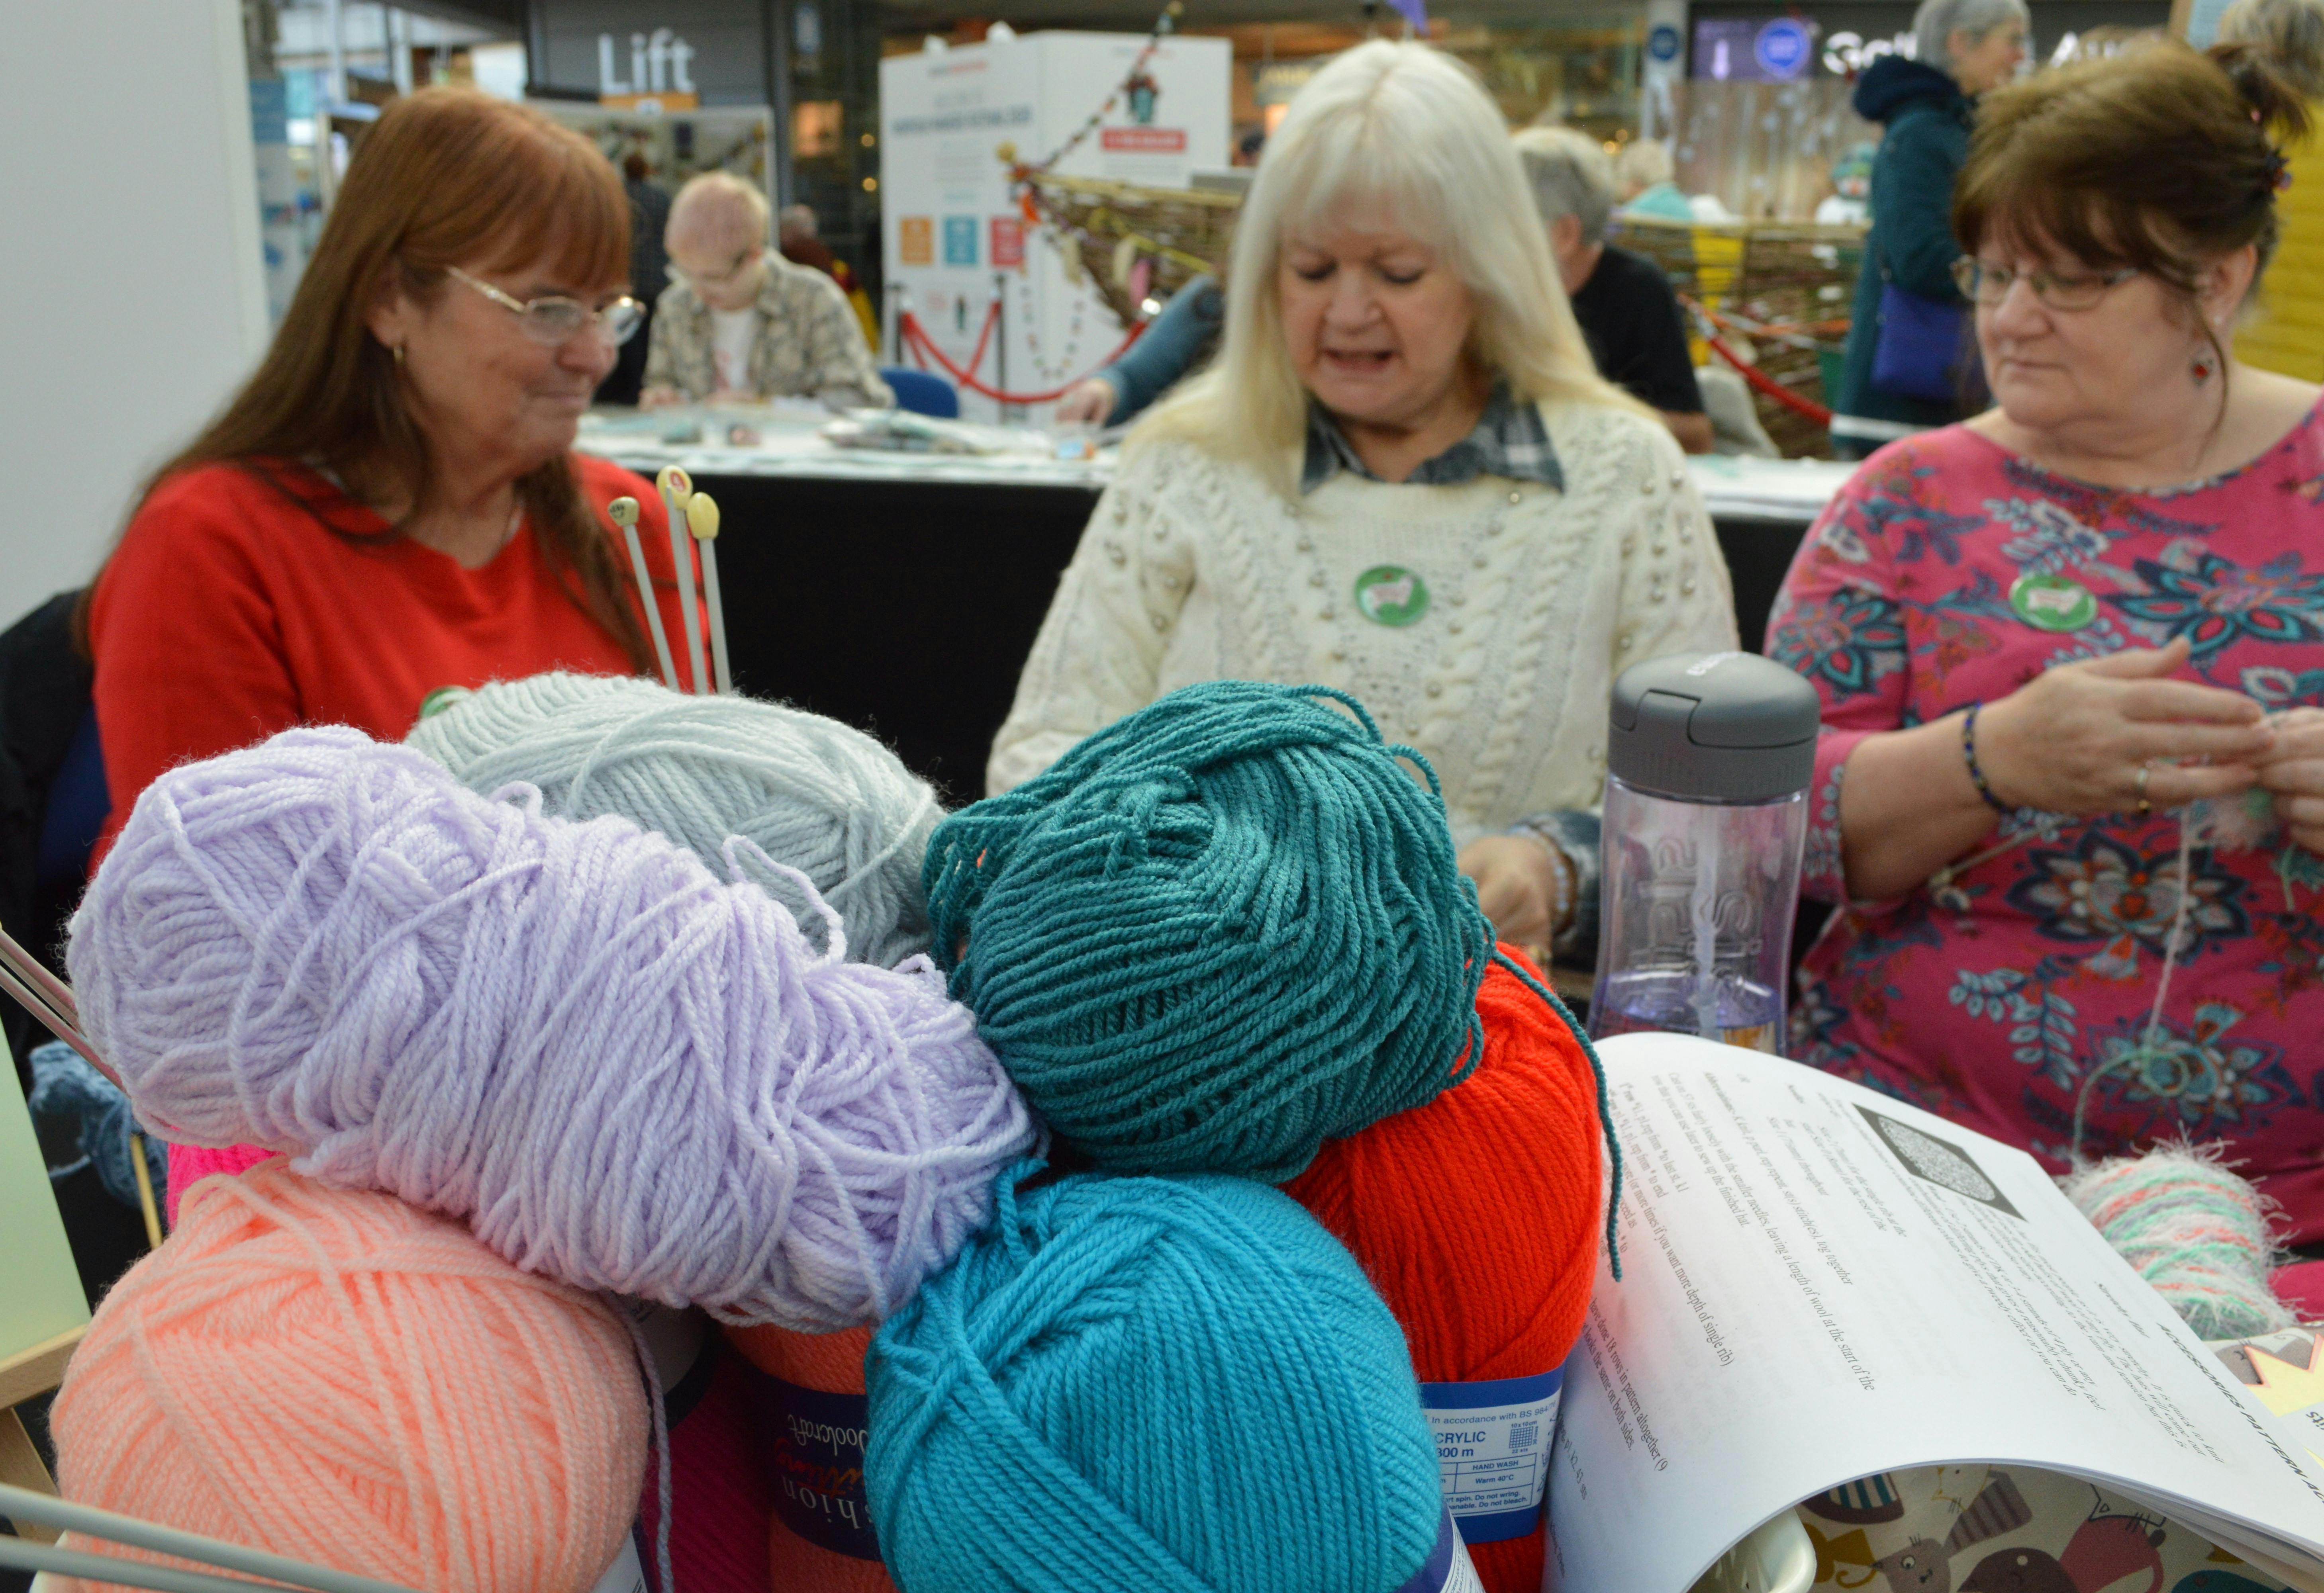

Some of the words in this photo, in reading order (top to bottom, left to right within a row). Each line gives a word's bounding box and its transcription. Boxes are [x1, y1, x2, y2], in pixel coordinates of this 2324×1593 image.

[598, 28, 696, 94] Lift
[1705, 1166, 1717, 1174] up
[1711, 1175, 1724, 1186] the
[1719, 1186, 1744, 1213] finished
[1735, 1213, 1750, 1227] hat.
[1732, 1174, 1753, 1198] smaller
[1747, 1199, 1769, 1226] needles,
[1654, 1234, 1672, 1250] you
[1765, 1227, 1788, 1254] leaving
[1793, 1206, 1822, 1239] stitch(es),
[1816, 1241, 1831, 1253] tog
[1826, 1254, 1852, 1284] together
[1666, 1249, 1682, 1269] want
[1675, 1268, 1691, 1289] more
[1787, 1261, 1811, 1285] length
[1686, 1289, 1706, 1312] depth
[1803, 1287, 1817, 1295] of
[1698, 1312, 1714, 1322] of
[1810, 1297, 1832, 1317] wool
[1597, 1318, 1614, 1341] done
[1822, 1319, 1836, 1327] at
[1962, 1262, 1983, 1279] give
[1984, 1286, 2010, 1311] tweedy
[2007, 1315, 2031, 1338] effect
[2026, 1339, 2039, 1349] or
[2036, 1351, 2052, 1366] you
[2049, 1367, 2066, 1382] can
[2063, 1384, 2076, 1395] do
[1606, 1338, 1617, 1353] 18
[1703, 1322, 1724, 1348] single
[1829, 1329, 1844, 1342] the
[2020, 1299, 2047, 1326] strands
[2043, 1327, 2060, 1338] of
[2055, 1344, 2073, 1356] ply
[2070, 1359, 2083, 1370] or
[2079, 1370, 2095, 1384] any
[1593, 1352, 1602, 1368] the
[1610, 1351, 1623, 1374] rows
[1717, 1348, 1734, 1366] rib)
[1838, 1344, 1859, 1363] start
[2020, 1315, 2059, 1358] reasonably
[2057, 1359, 2087, 1391] chunky
[2083, 1392, 2106, 1410] feel.
[1598, 1367, 1611, 1391] same
[1618, 1372, 1627, 1384] in
[1851, 1365, 1868, 1374] of
[1858, 1376, 1874, 1390] the
[1607, 1389, 1616, 1403] on
[1621, 1382, 1640, 1415] pattern
[2102, 1354, 2122, 1370] and
[2117, 1371, 2147, 1401] tension
[2144, 1403, 2162, 1419] but
[2159, 1420, 2177, 1437] this
[2175, 1439, 2186, 1448] is
[1444, 1415, 1496, 1425] accordance
[1499, 1412, 1517, 1421] with
[1519, 1410, 1532, 1419] BS
[1611, 1398, 1626, 1425] both
[2159, 1325, 2244, 1409] ACCESSORIES
[2241, 1412, 2307, 1477] PATTERN
[2301, 1478, 2324, 1504] AC
[2306, 1411, 2324, 1430] its
[1621, 1422, 1634, 1450] sides.
[1636, 1413, 1660, 1460] altogether
[2149, 1394, 2170, 1412] will
[2164, 1413, 2189, 1437] come
[2187, 1440, 2206, 1456] out
[2159, 1393, 2170, 1401] is
[2168, 1403, 2195, 1427] quick
[2192, 1431, 2204, 1441] to
[2203, 1444, 2223, 1462] knit
[1435, 1431, 1486, 1444] CRYLIC
[1437, 1447, 1458, 1458] 300
[1461, 1448, 1474, 1457] m
[1654, 1458, 1668, 1471] (9
[1503, 1496, 1528, 1505] bleach.
